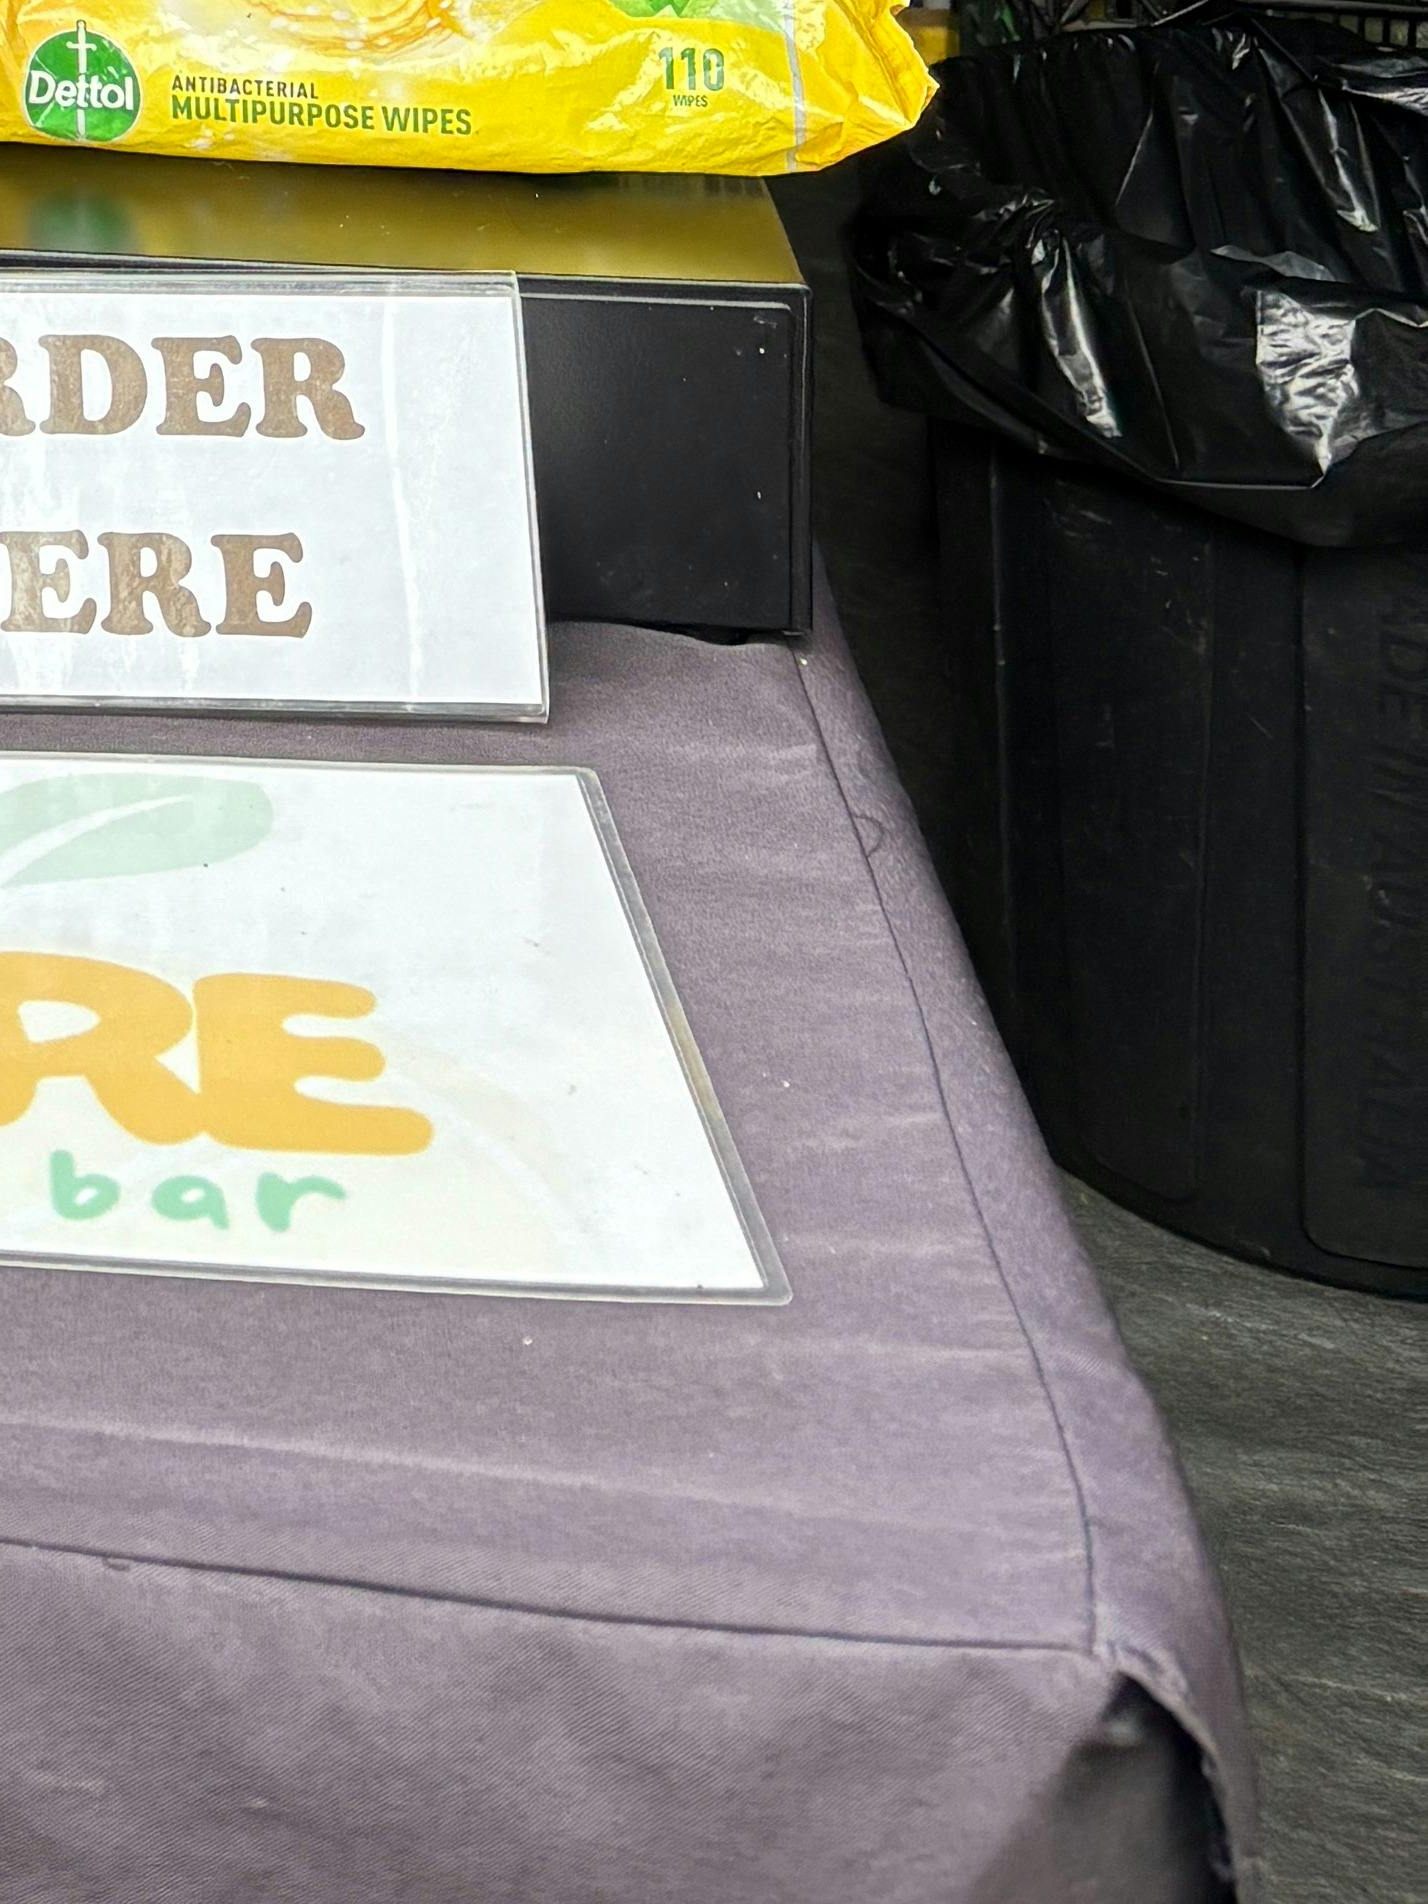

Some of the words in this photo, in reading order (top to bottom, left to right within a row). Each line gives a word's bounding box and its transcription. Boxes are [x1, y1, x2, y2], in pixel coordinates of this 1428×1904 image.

[27, 69, 135, 111] Dettol
[171, 74, 320, 100] ANTIBACTERIAL
[658, 46, 725, 92] 110
[171, 94, 375, 131] MULTIPURPOSE
[380, 104, 474, 137] WIPES
[673, 94, 709, 108] WIPES
[49, 1146, 352, 1234] bar
